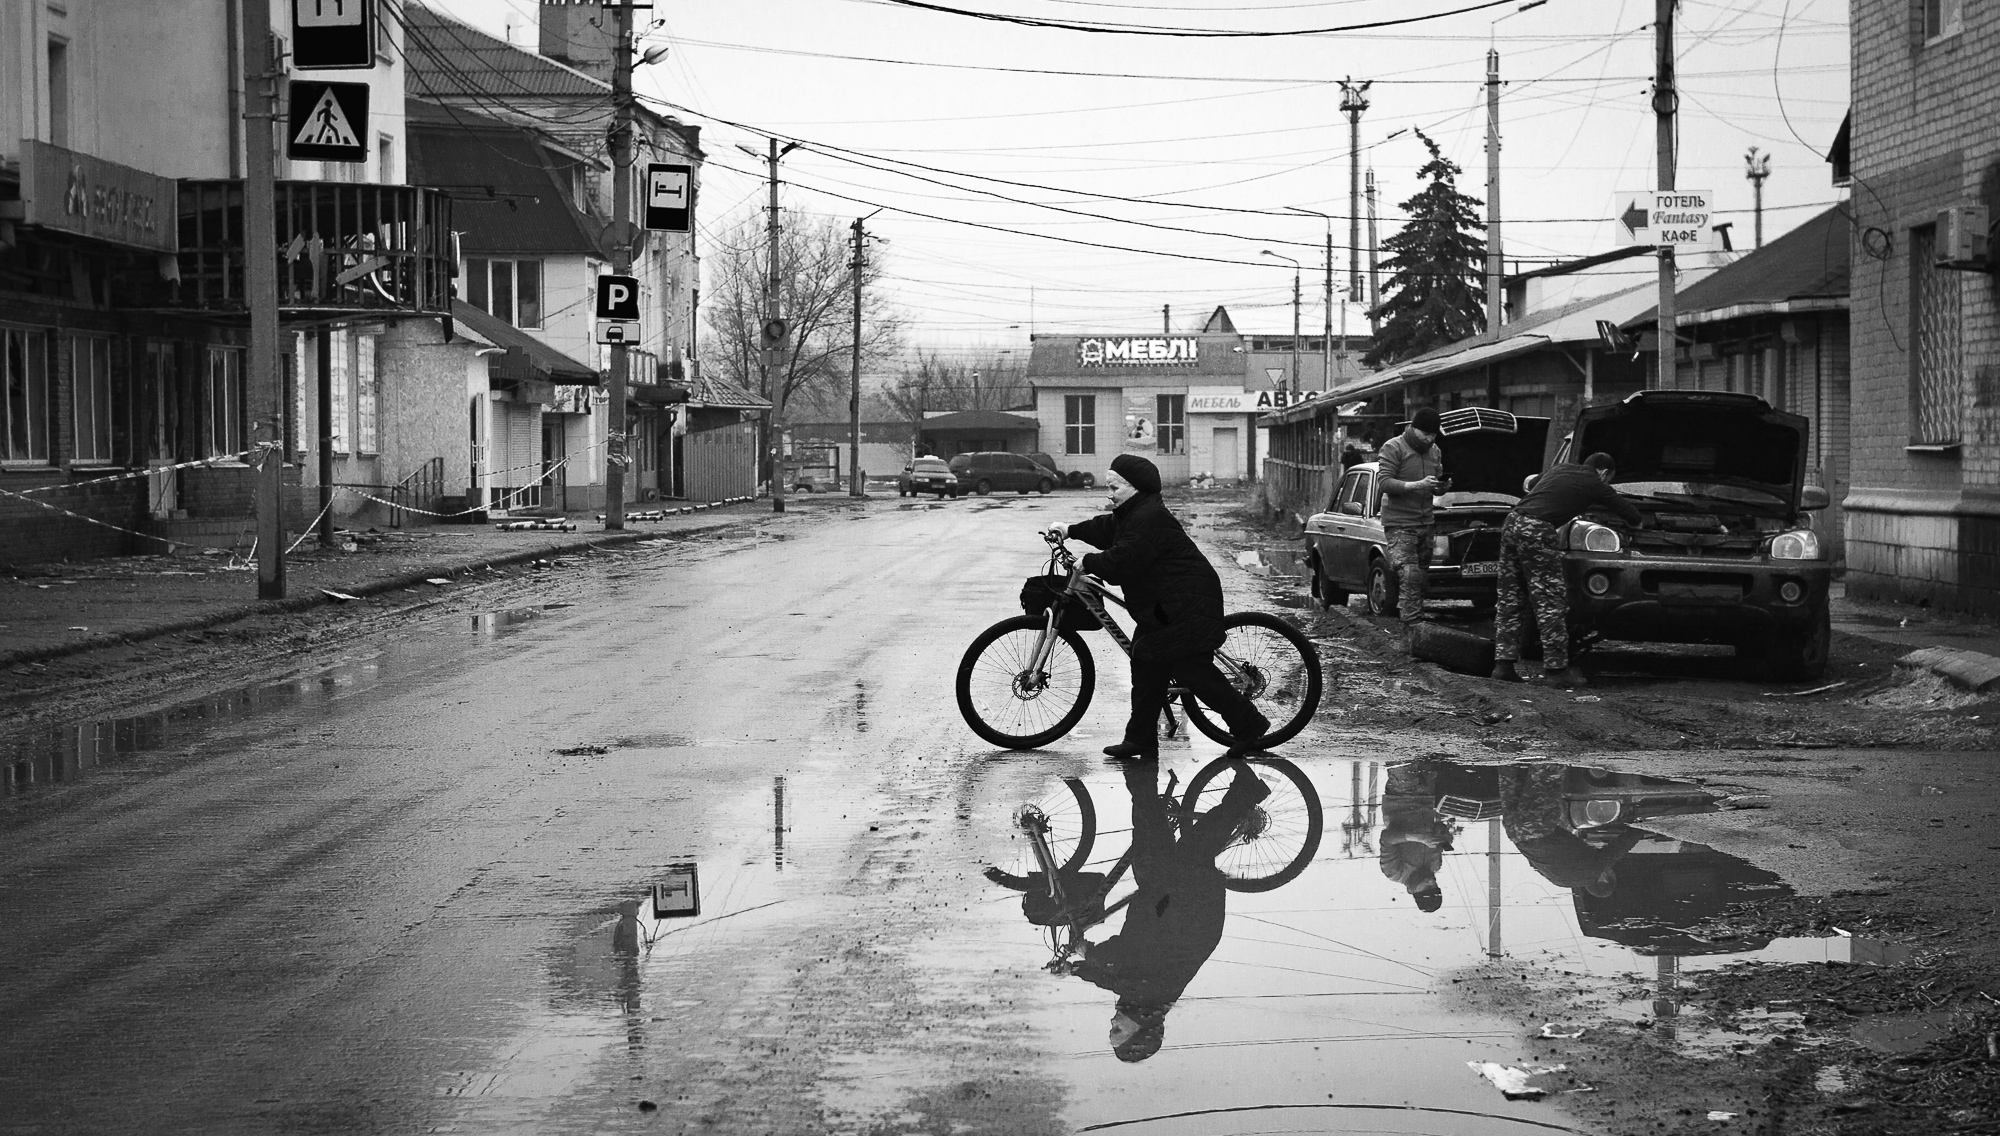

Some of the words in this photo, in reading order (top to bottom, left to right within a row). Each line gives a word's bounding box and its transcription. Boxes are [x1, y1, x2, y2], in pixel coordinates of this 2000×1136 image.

[1656, 195, 1706, 208] ГОТЕЛЬ
[1652, 210, 1709, 228] Fantasy
[1661, 229, 1698, 242] КАФЕ
[608, 284, 630, 310] P
[1105, 339, 1198, 359] МЕБЛІ
[1191, 397, 1241, 408] МЕБЕЛЬ
